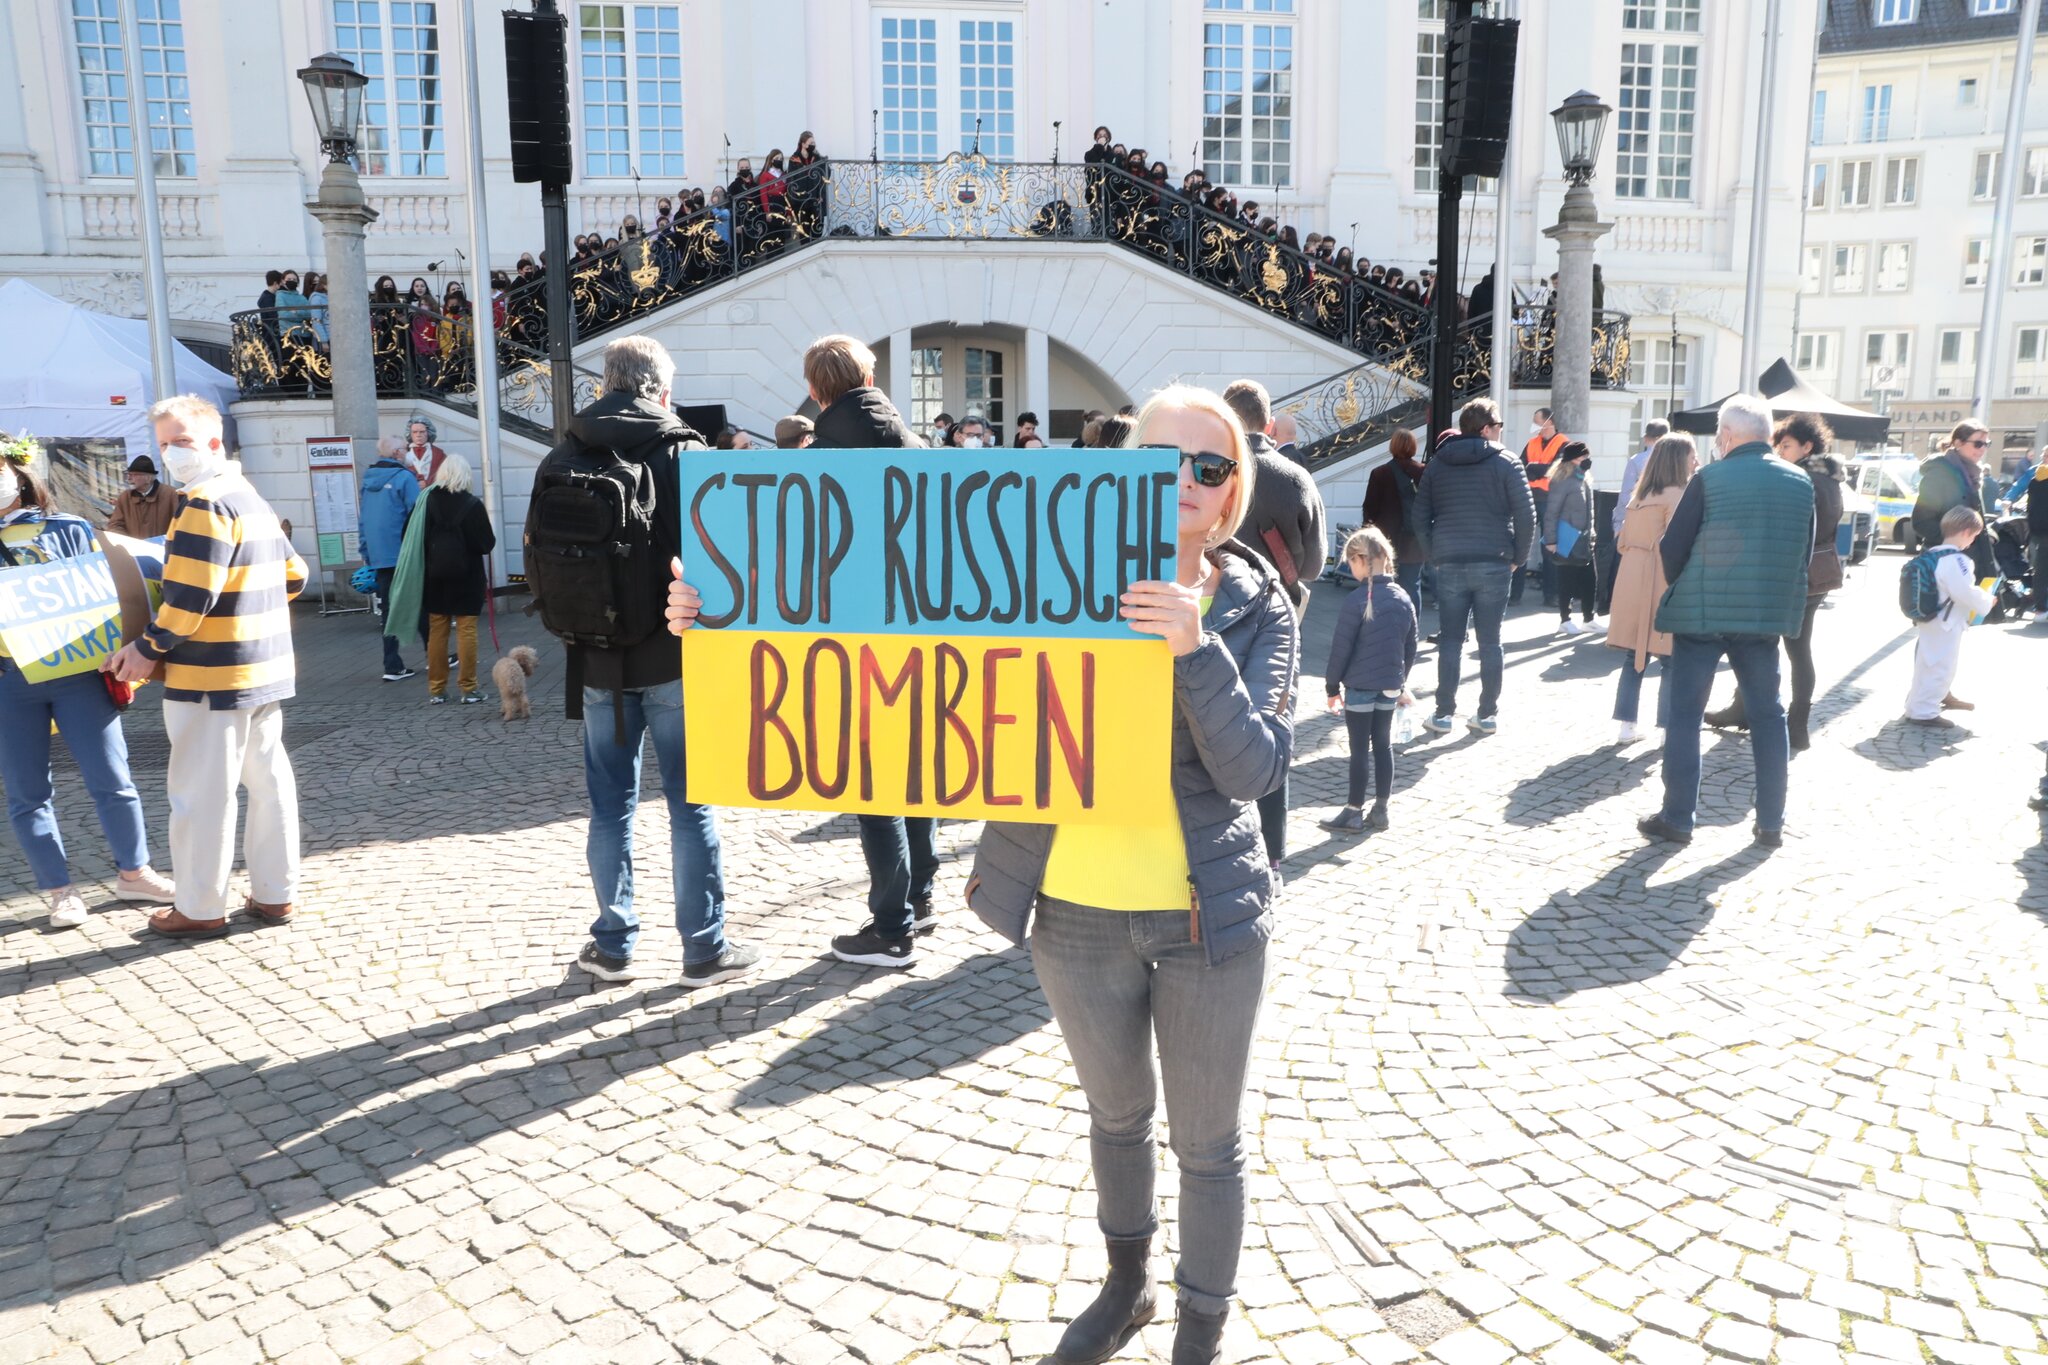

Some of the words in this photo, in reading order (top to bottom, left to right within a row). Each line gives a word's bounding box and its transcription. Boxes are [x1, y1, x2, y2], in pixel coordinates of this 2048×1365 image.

[690, 472, 854, 629] STOP
[884, 465, 1178, 625] RUSSISCHE
[747, 638, 1096, 810] BOMBEN
